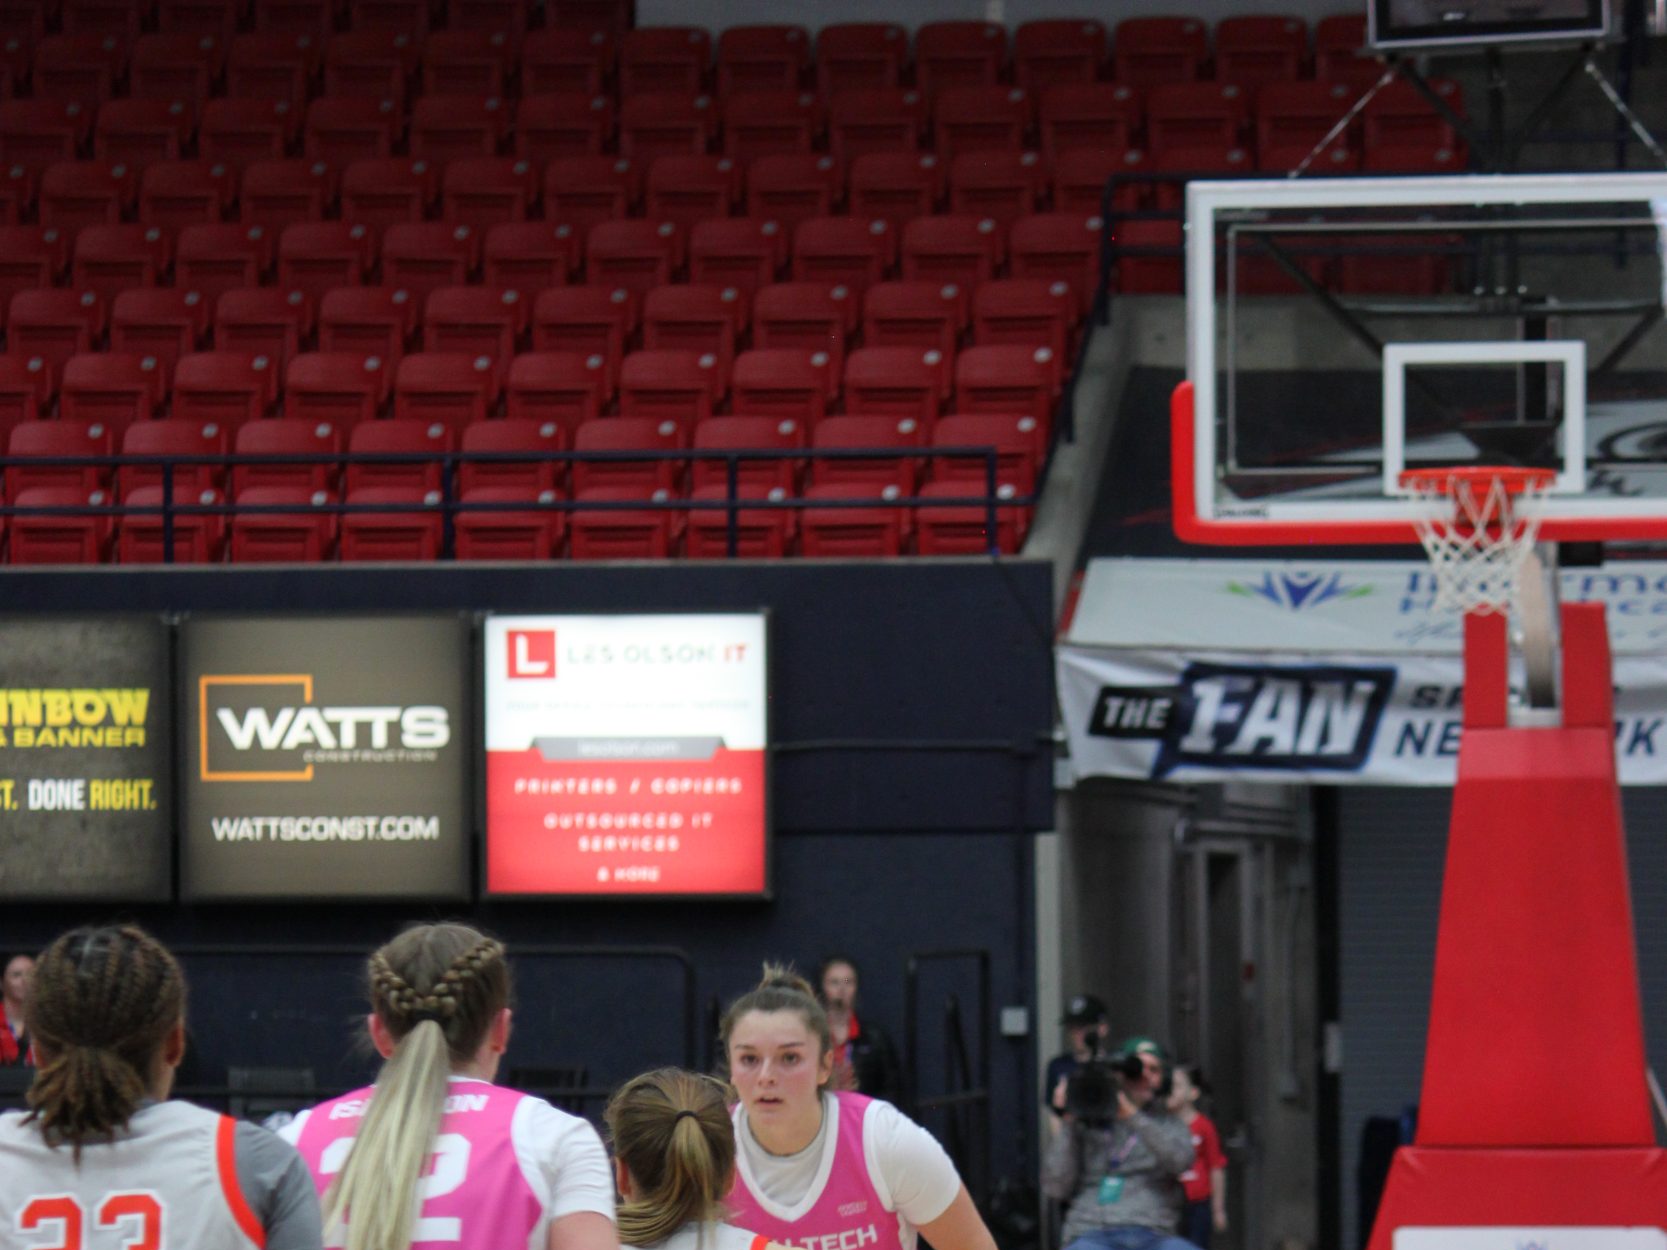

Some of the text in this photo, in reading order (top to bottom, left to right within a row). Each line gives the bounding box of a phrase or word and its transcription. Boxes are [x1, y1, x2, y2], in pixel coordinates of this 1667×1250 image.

[723, 642, 748, 663] IT
[1102, 697, 1174, 730] THE
[1178, 675, 1378, 756] FAN
[14, 727, 146, 747] BANNER
[216, 706, 450, 750] WATTS
[303, 750, 438, 764] CONSTRUCTION
[28, 779, 86, 810] DONE
[90, 779, 157, 810] RIGHT.
[514, 777, 617, 795] PRINTERS
[650, 777, 742, 795] COPIERS
[211, 816, 440, 841] WATTSCONST.COM
[578, 835, 680, 853] SERVICES
